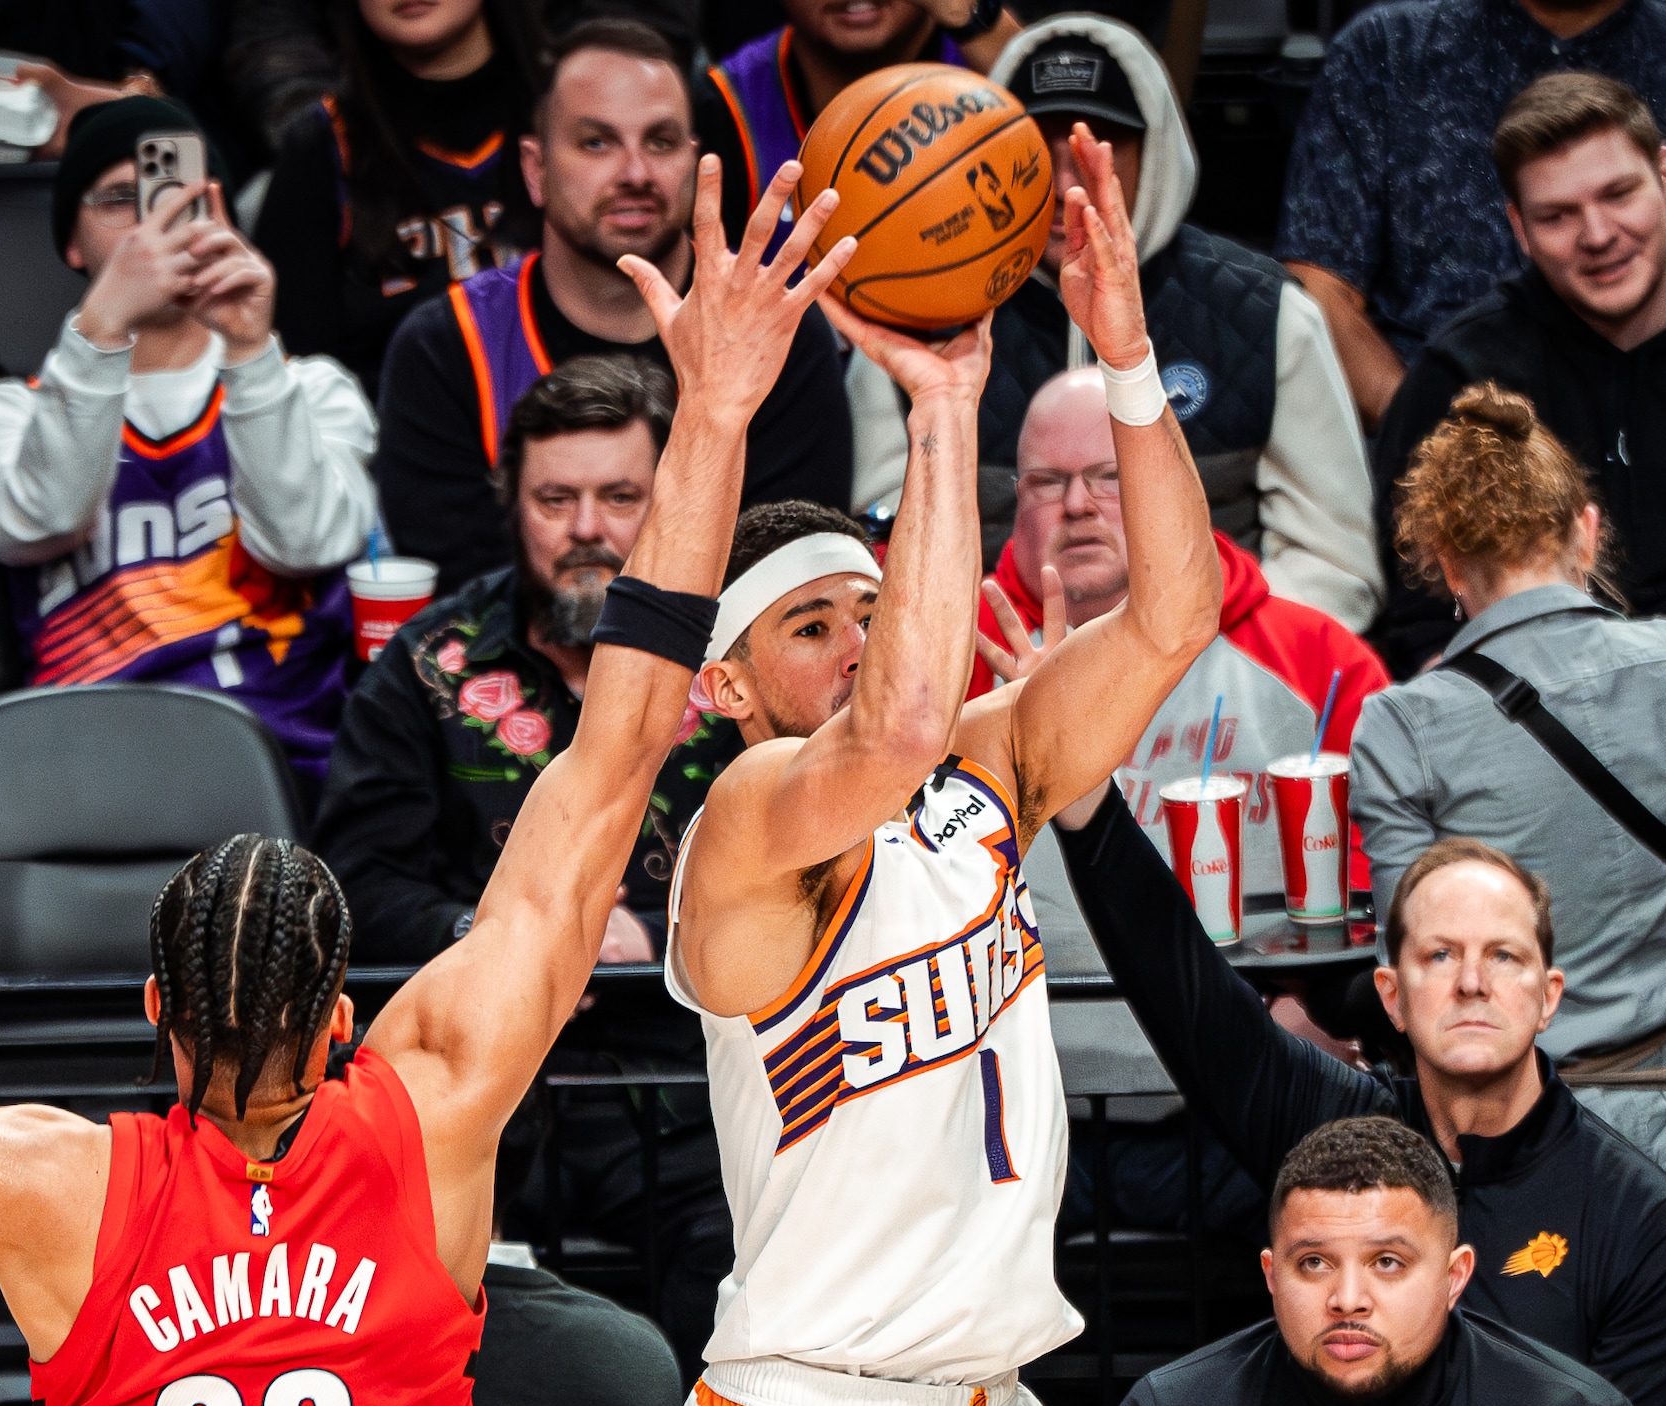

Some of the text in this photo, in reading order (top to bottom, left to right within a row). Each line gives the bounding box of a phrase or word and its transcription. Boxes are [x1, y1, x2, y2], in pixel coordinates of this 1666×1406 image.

[933, 794, 986, 847] PayPal
[1302, 834, 1339, 853] Coke
[1190, 858, 1229, 877] Coke
[979, 1047, 1022, 1184] 1
[129, 1242, 378, 1352] CAMARA
